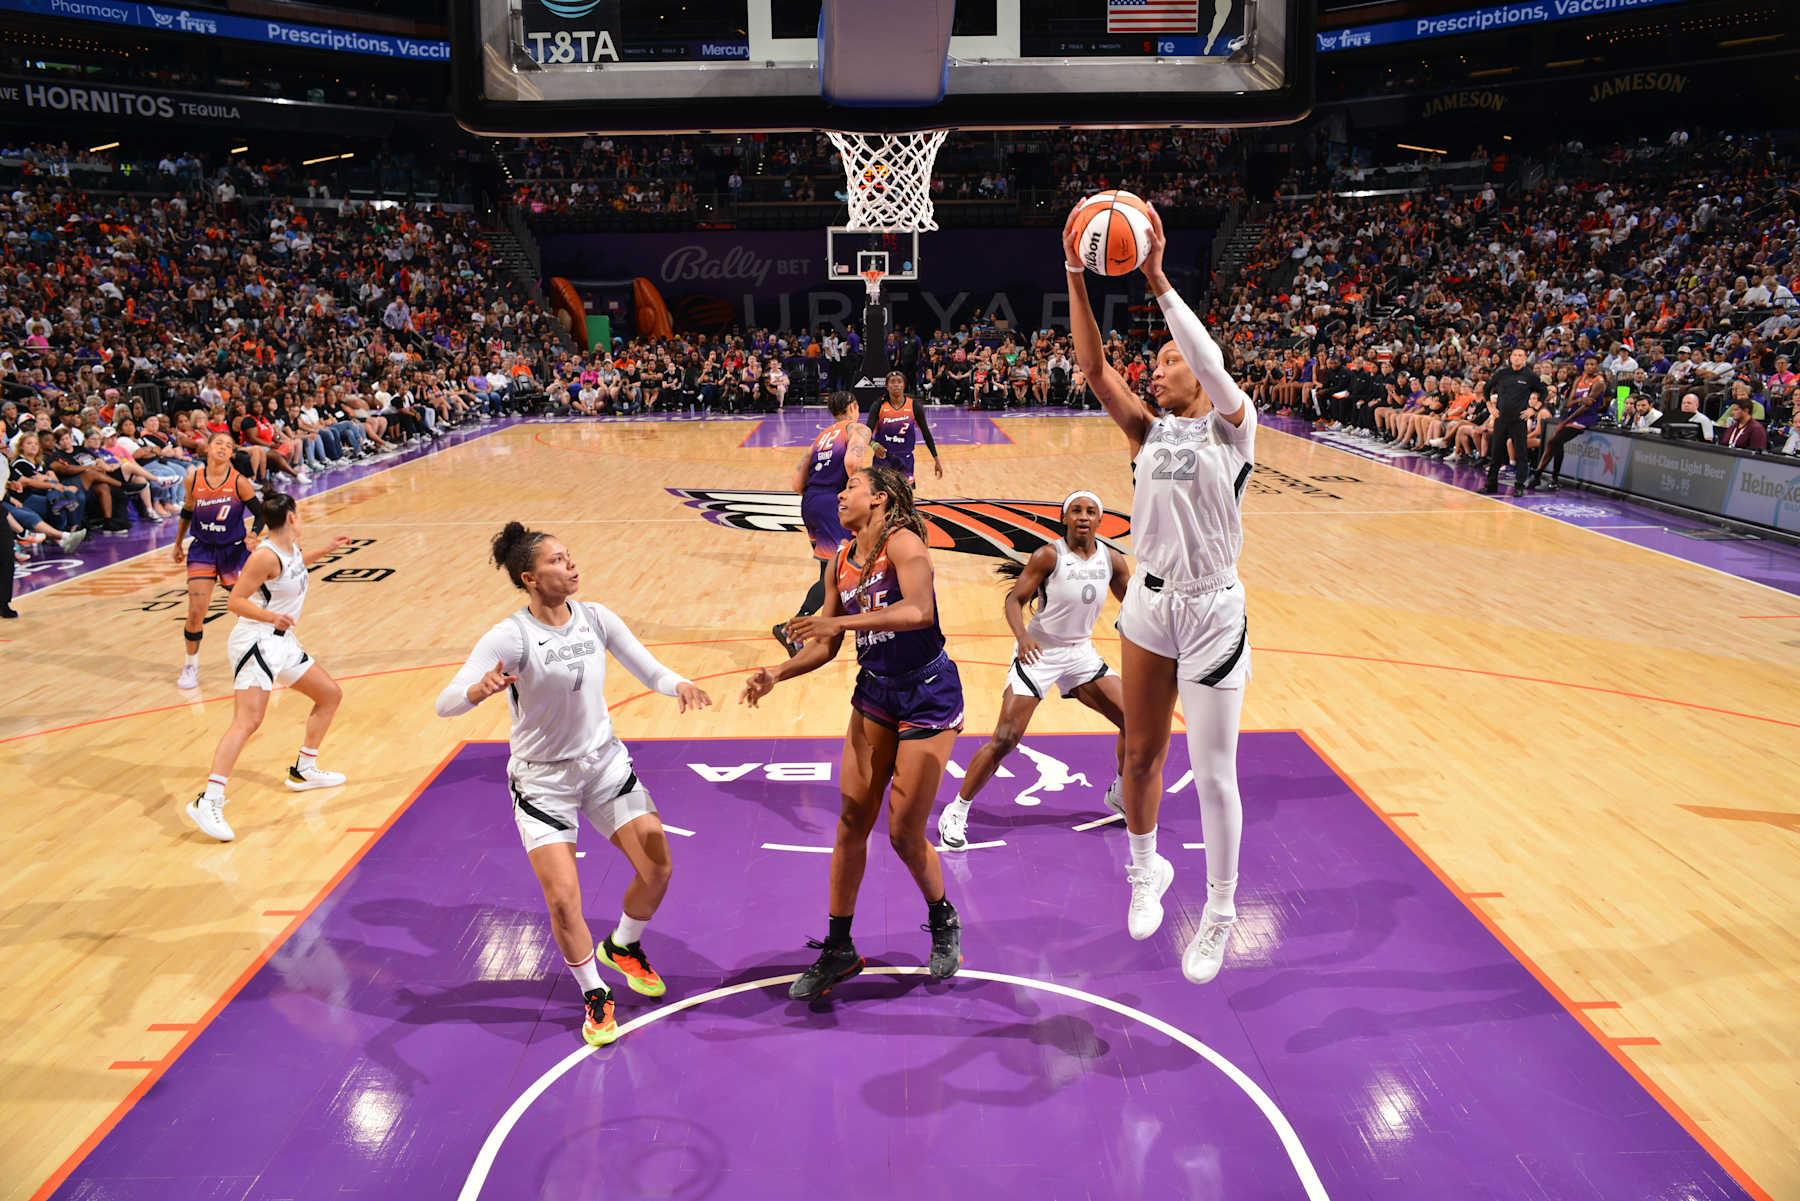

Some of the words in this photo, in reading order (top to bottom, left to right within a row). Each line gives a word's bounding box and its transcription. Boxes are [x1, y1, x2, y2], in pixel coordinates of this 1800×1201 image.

[51, 0, 129, 22] Pharmacy
[1416, 6, 1550, 35] Prescriptions,
[267, 23, 394, 56] Prescriptions,
[702, 44, 750, 59] Mercury
[1587, 72, 1688, 103] JAMESON
[24, 83, 175, 118] HORNITOS
[179, 102, 241, 119] TEQUILA
[1422, 91, 1506, 118] JAMESON
[660, 246, 772, 286] Bally
[776, 258, 812, 276] BET
[817, 428, 841, 452] 42
[898, 422, 910, 435] 2
[1151, 448, 1196, 480] 22
[1680, 458, 1703, 476] Light
[1704, 463, 1727, 481] Beer
[216, 504, 231, 521] 0
[1066, 568, 1106, 580] ACES
[1081, 583, 1097, 604] 0
[544, 639, 596, 665] ACES
[567, 659, 585, 692] 7
